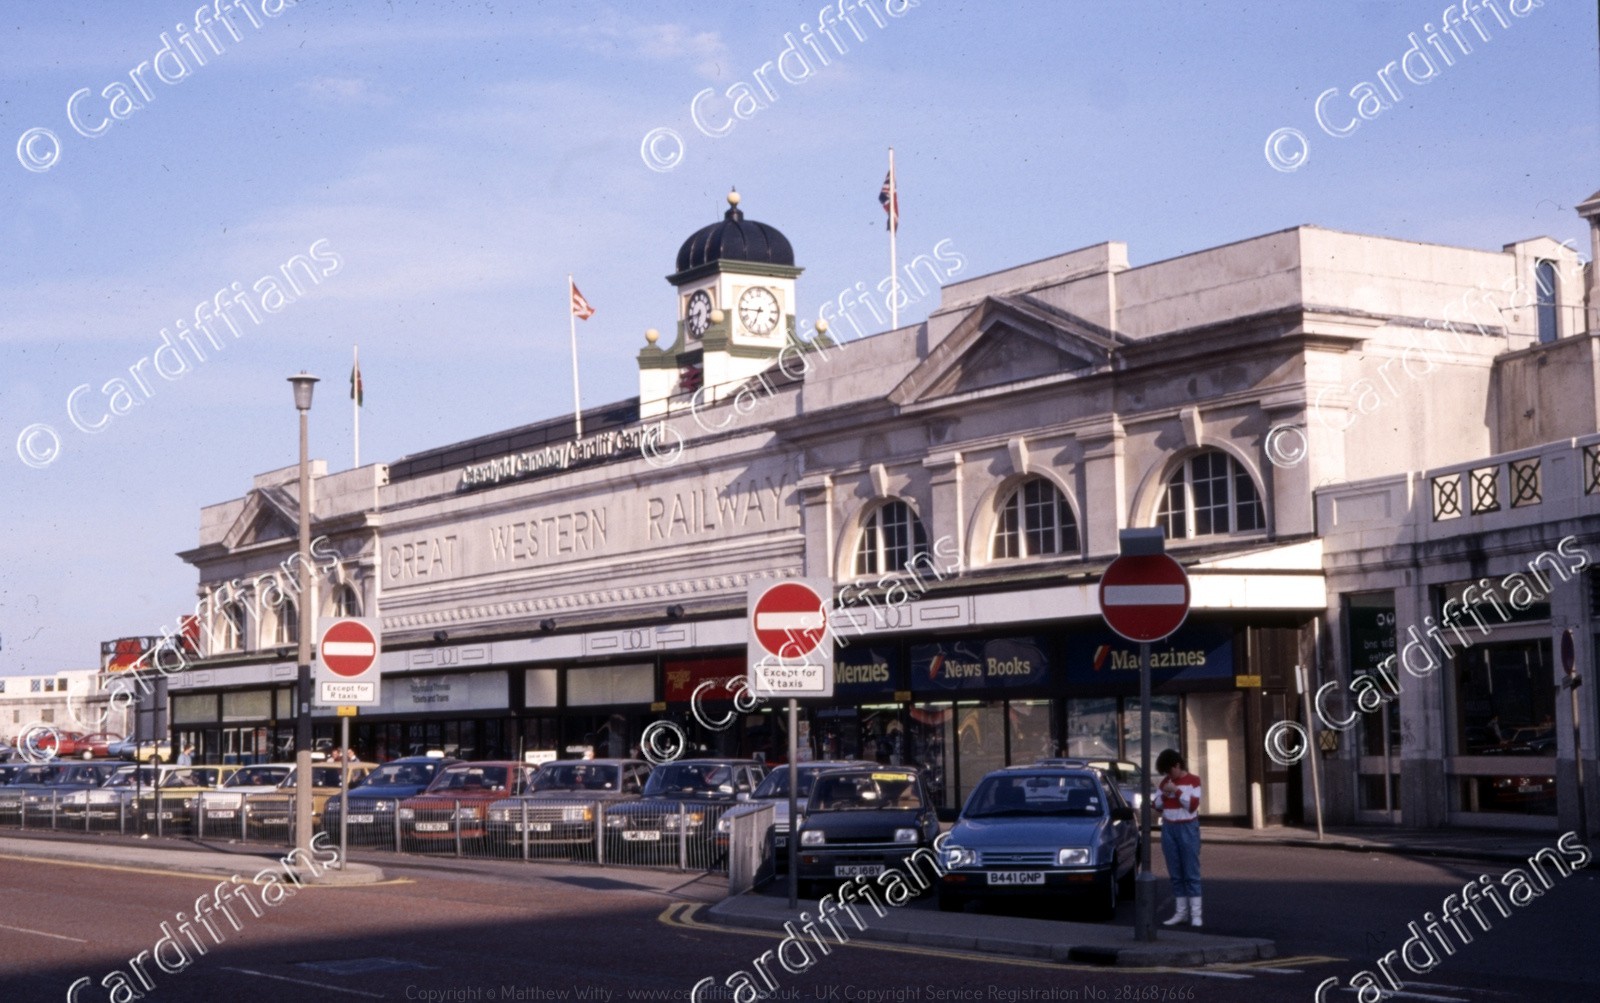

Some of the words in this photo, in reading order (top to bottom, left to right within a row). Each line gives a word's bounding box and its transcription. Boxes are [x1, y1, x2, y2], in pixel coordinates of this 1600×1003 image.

[387, 535, 457, 581] GREAT
[490, 507, 609, 564] WESTERN
[647, 473, 789, 540] RAILWAY
[1111, 647, 1206, 672] Maazines
[833, 661, 890, 684] Menzies
[944, 660, 982, 678] News
[987, 656, 1031, 677] Books
[763, 668, 798, 678] Except
[802, 669, 817, 677] for
[327, 684, 355, 692] Except
[777, 679, 803, 688] taxis
[838, 867, 857, 876] HJC
[991, 873, 1017, 882] B441
[1019, 872, 1042, 883] GNP
